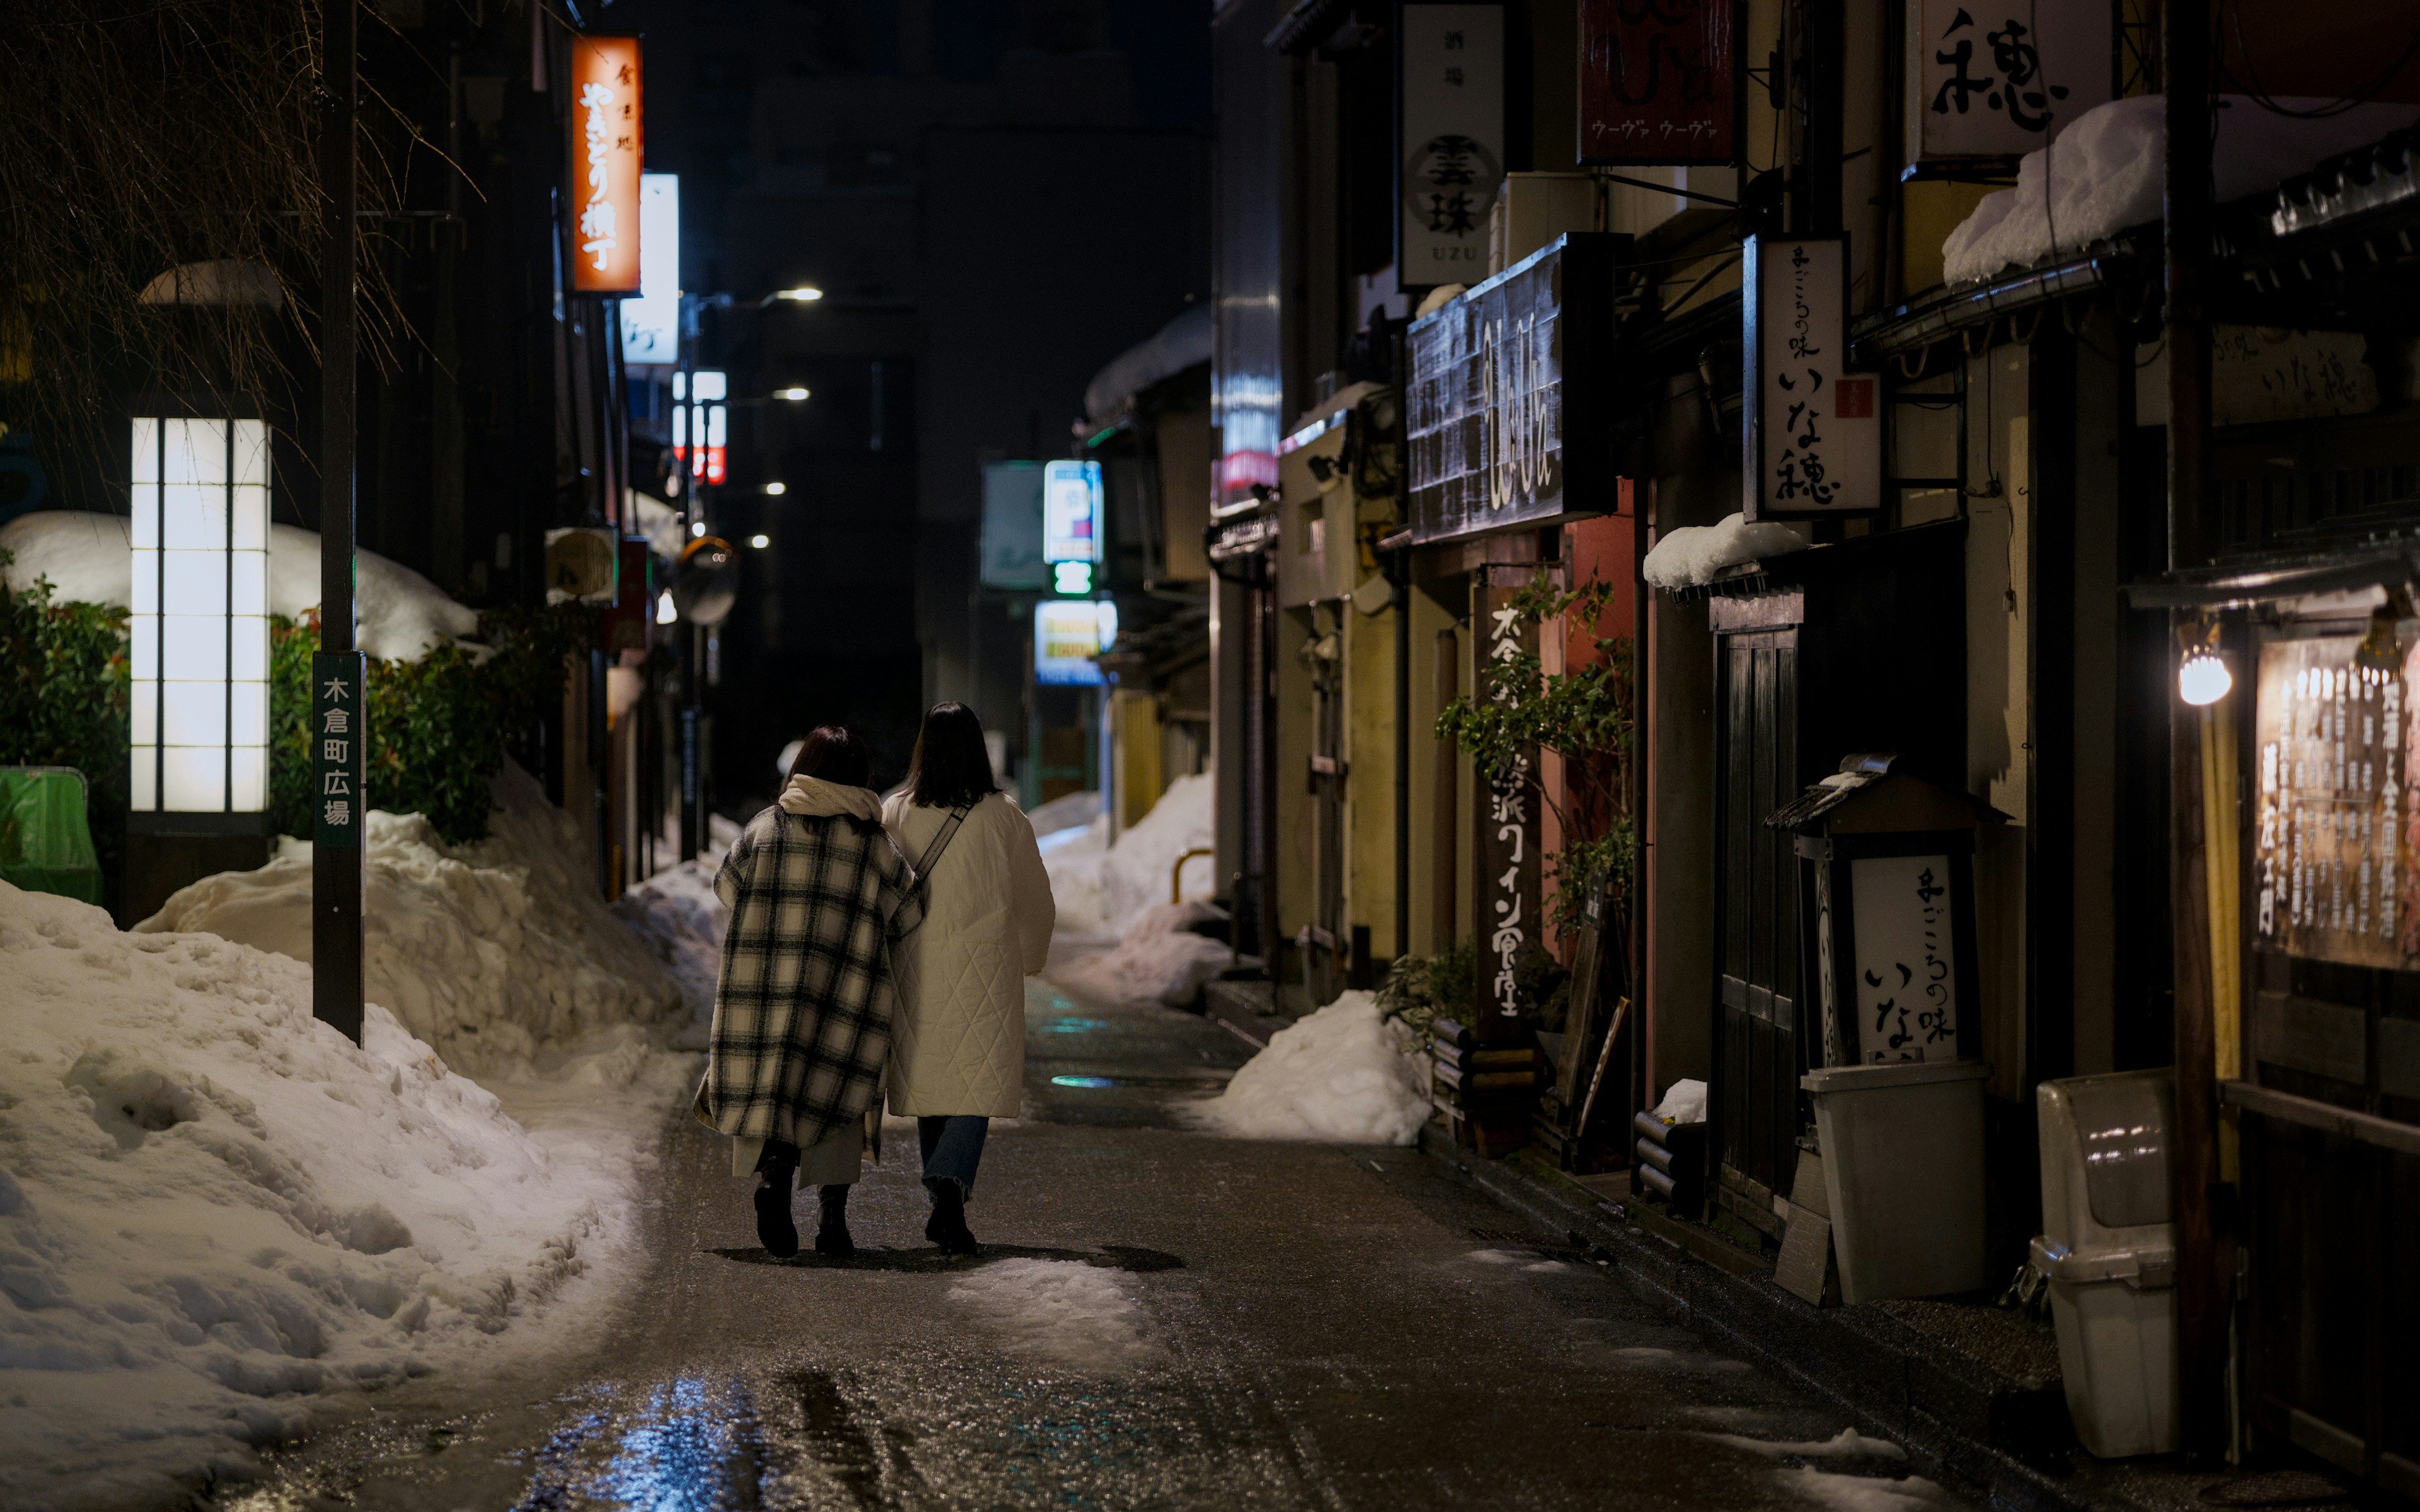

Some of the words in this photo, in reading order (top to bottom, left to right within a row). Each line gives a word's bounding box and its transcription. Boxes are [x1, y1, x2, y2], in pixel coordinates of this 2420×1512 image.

[1592, 119, 1650, 140] ウーヴァ
[1659, 119, 1717, 140] ウーヴァ
[1932, 7, 2069, 132] 穂
[579, 82, 617, 271] やきとり横丁
[1432, 246, 1478, 261] UZU
[1789, 245, 1820, 358] まごころの味
[1776, 368, 1841, 505] いな穂
[323, 677, 350, 826] 木倉町広場
[1865, 962, 1913, 1060] いな
[1917, 867, 1956, 1045] まごころの味
